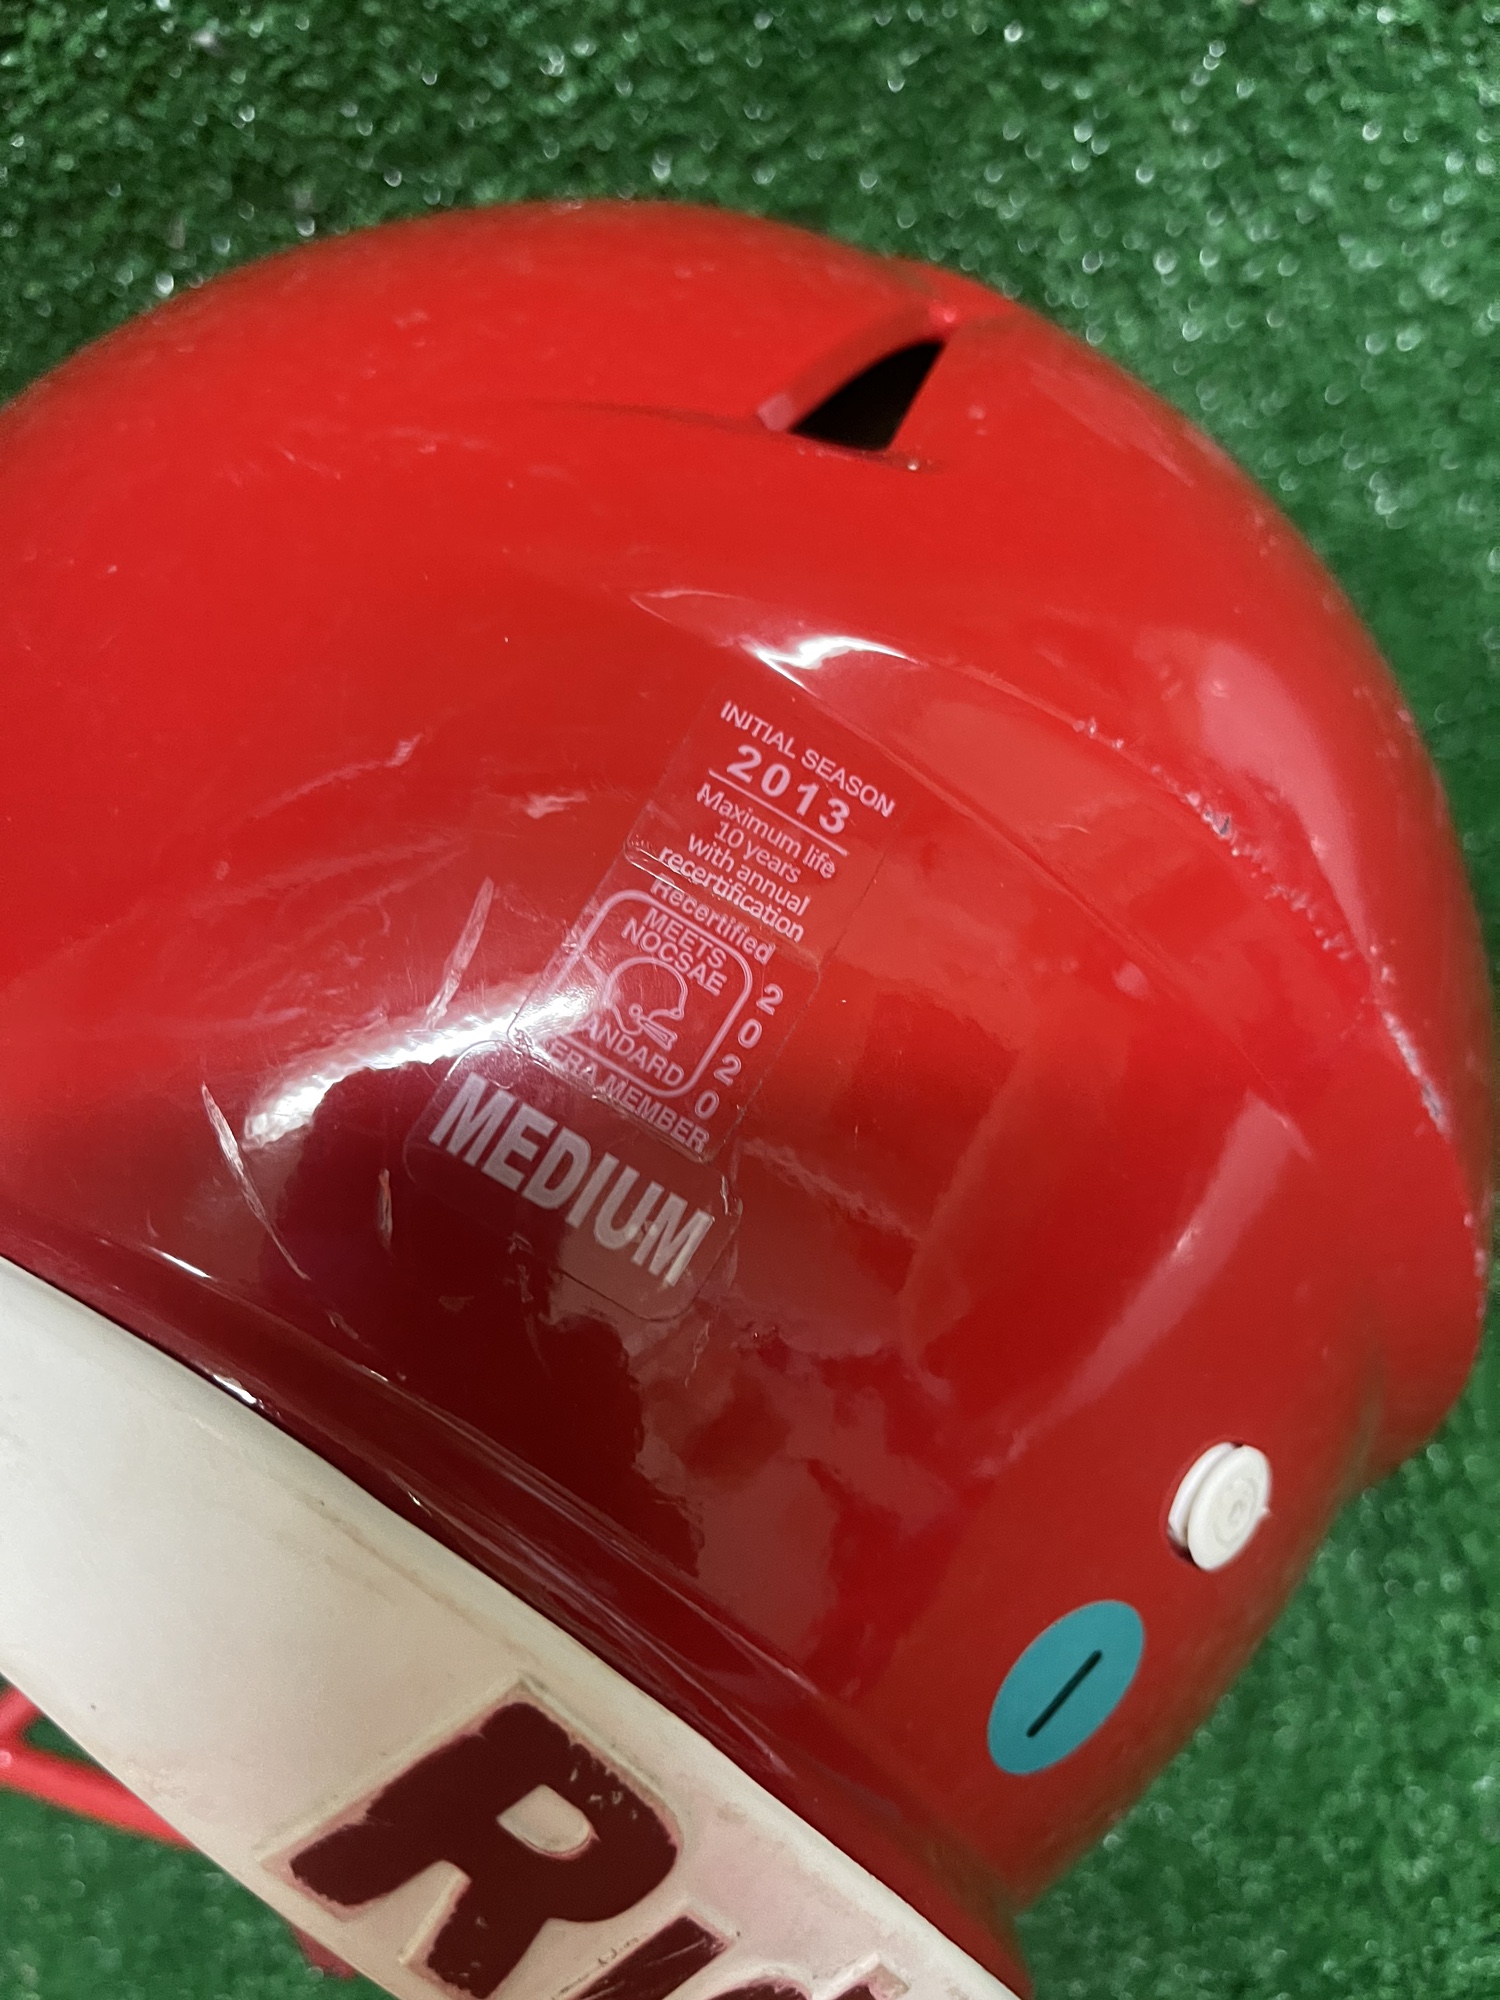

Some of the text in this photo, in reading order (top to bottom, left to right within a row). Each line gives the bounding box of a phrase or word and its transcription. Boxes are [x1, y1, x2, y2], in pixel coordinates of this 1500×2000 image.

[720, 700, 896, 818] INITIAL SEASON
[727, 744, 850, 834] 2013
[696, 782, 836, 879] Maximum life
[714, 821, 802, 884] 10 years
[658, 846, 805, 943] recertification
[688, 833, 811, 916] with annual
[621, 916, 728, 996] NOCSAE
[642, 906, 727, 969] MEETS
[650, 872, 776, 965] Recertified
[580, 1014, 685, 1087] ANDARD
[601, 1073, 710, 1153] MEMBER
[428, 1071, 716, 1287] MEDIUM
